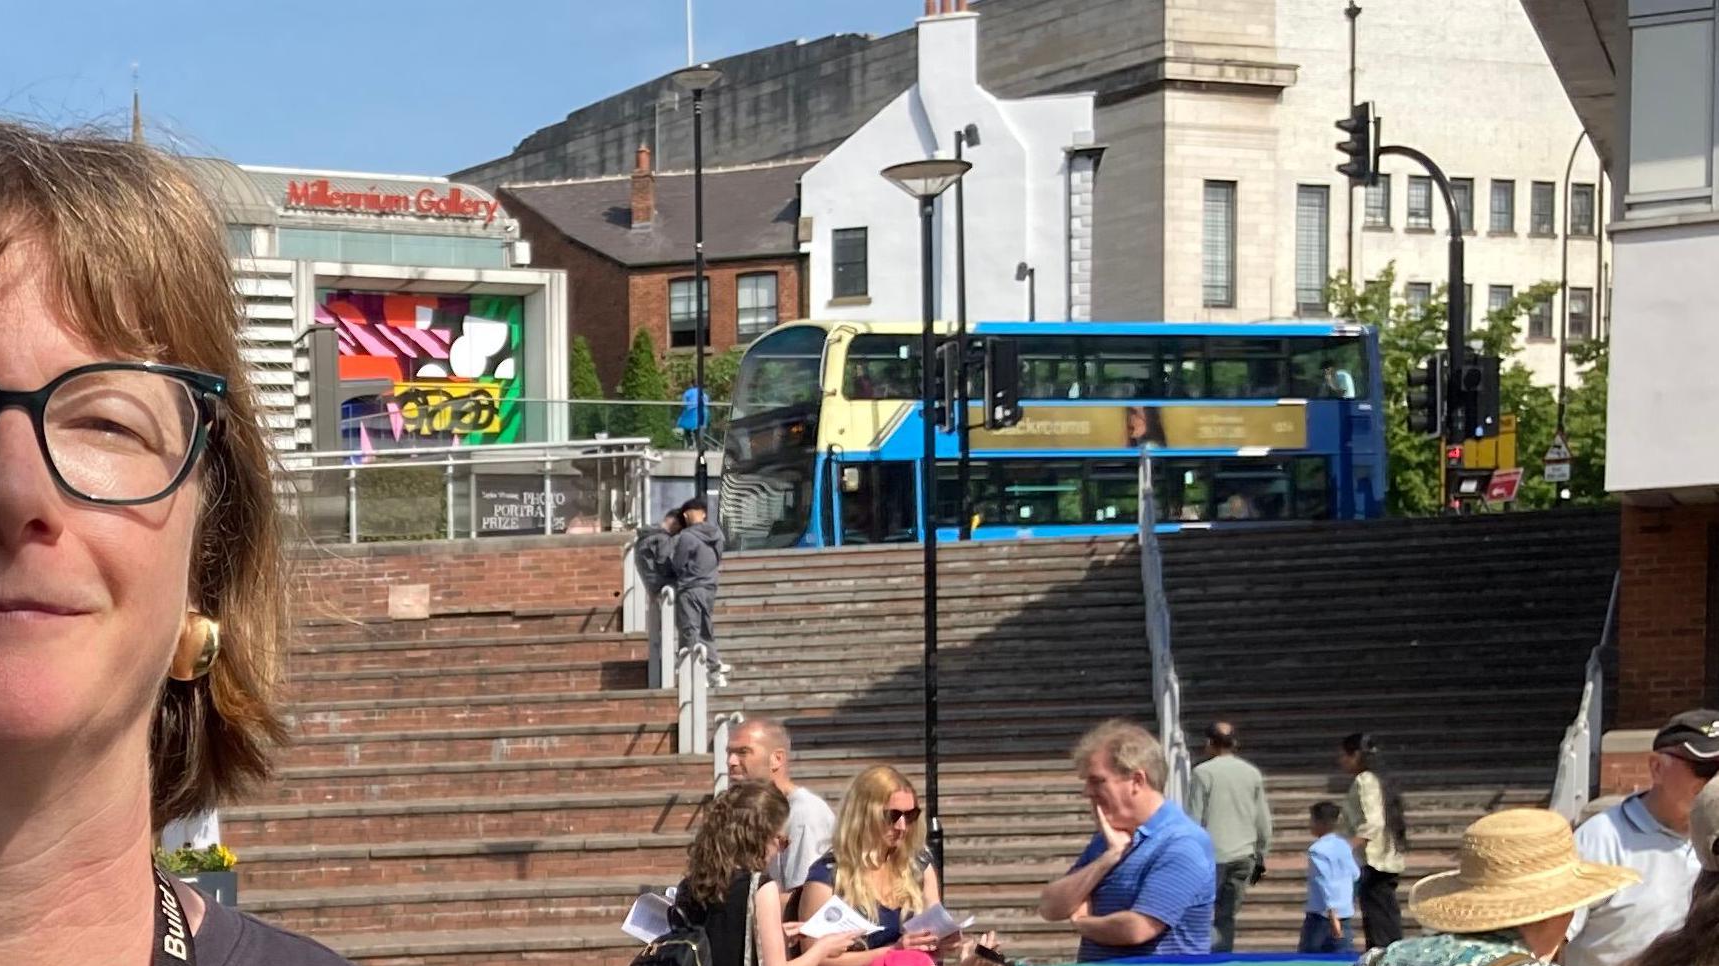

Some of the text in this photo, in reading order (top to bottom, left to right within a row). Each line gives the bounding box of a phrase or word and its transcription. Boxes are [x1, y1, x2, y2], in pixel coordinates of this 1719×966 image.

[286, 177, 500, 223] Millennium Gallery
[523, 491, 565, 506] PHOO
[482, 516, 519, 530] PRIZE
[157, 884, 188, 961] Build
